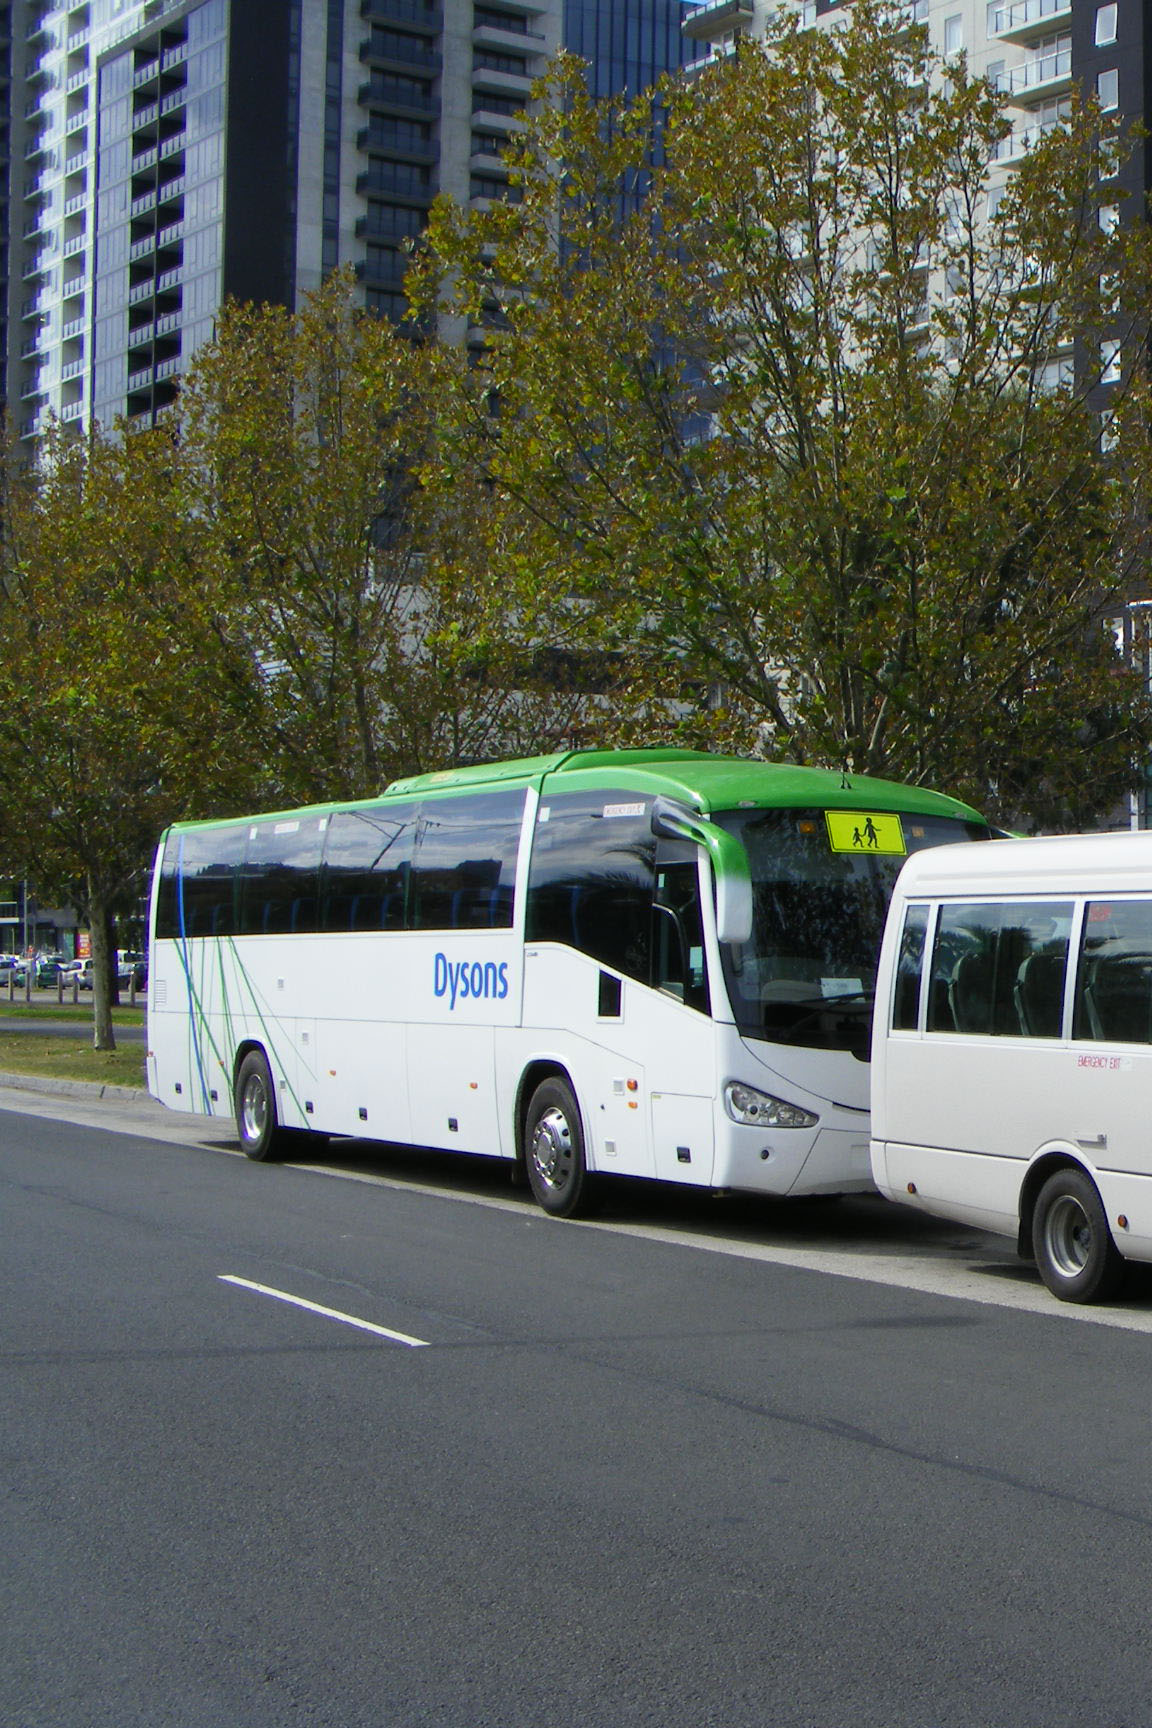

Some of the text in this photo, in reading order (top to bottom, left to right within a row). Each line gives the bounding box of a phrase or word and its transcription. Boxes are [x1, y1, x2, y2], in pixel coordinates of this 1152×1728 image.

[434, 952, 508, 1010] Dysons
[1077, 1055, 1120, 1070] EMERGENCY EXIT
